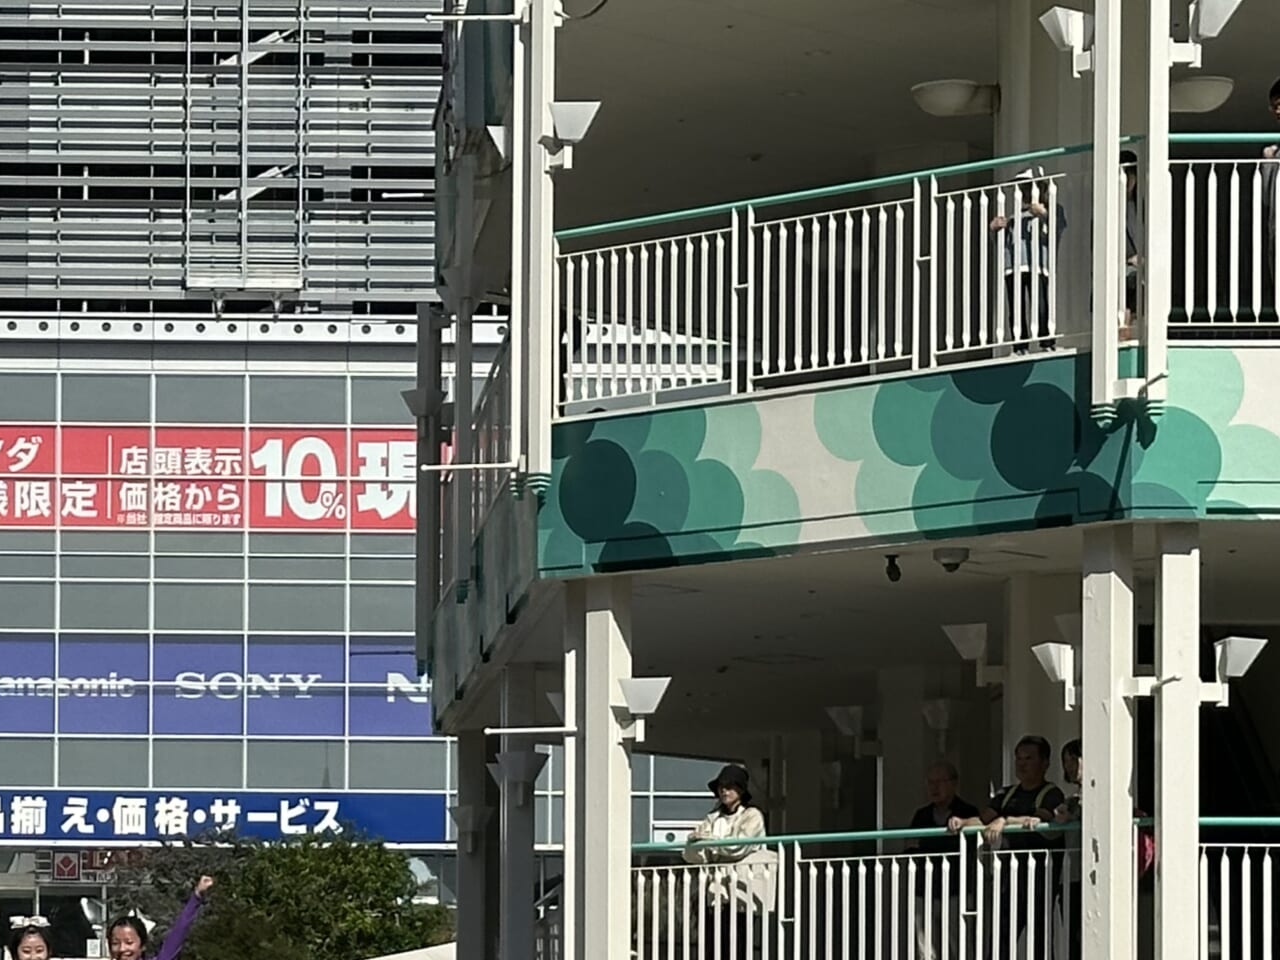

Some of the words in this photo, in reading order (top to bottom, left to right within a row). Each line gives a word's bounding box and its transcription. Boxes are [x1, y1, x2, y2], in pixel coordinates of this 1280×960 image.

[119, 446, 242, 476] 店頭表示
[251, 436, 346, 521] 10%
[118, 481, 241, 511] 価格から
[175, 671, 322, 699] SONY
